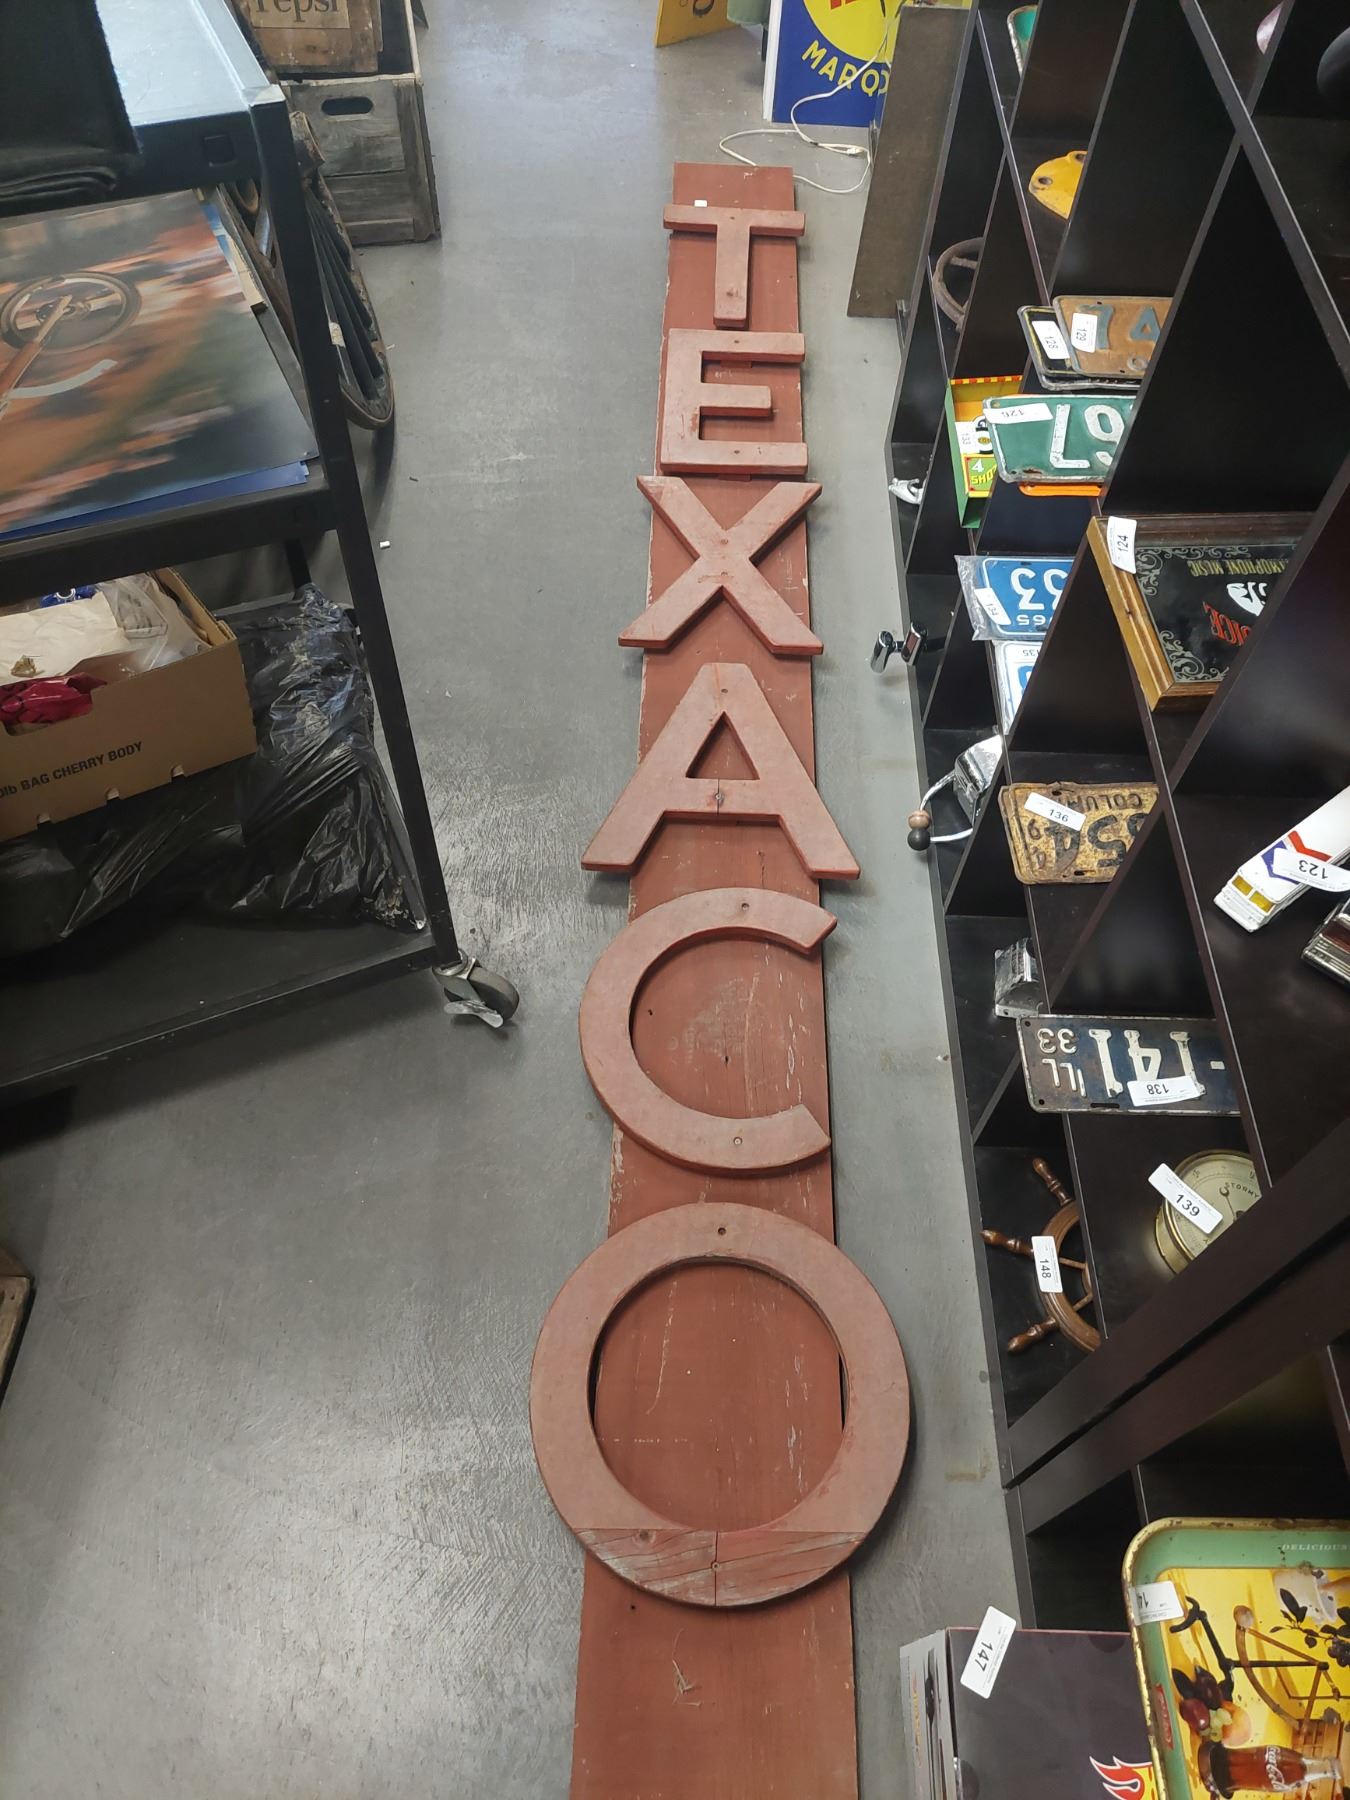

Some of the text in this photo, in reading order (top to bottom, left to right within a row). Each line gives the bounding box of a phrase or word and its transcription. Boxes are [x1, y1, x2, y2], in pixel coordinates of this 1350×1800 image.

[971, 459, 984, 473] 4
[1117, 535, 1129, 552] 124
[1186, 560, 1223, 577] MUSIC
[20, 773, 50, 791] BAG
[52, 753, 105, 780] CHERRY
[107, 740, 143, 763] BODY
[1049, 808, 1069, 823] 136
[1298, 859, 1329, 880] 123
[530, 204, 911, 1609] TEXACO
[1037, 1028, 1077, 1053] 33
[1042, 1058, 1087, 1097] ILL
[1146, 1083, 1169, 1095] 138
[1225, 1182, 1260, 1200] STORMY
[1174, 1193, 1200, 1217] 139
[1039, 1258, 1052, 1279] 148
[974, 1640, 994, 1672] 147
